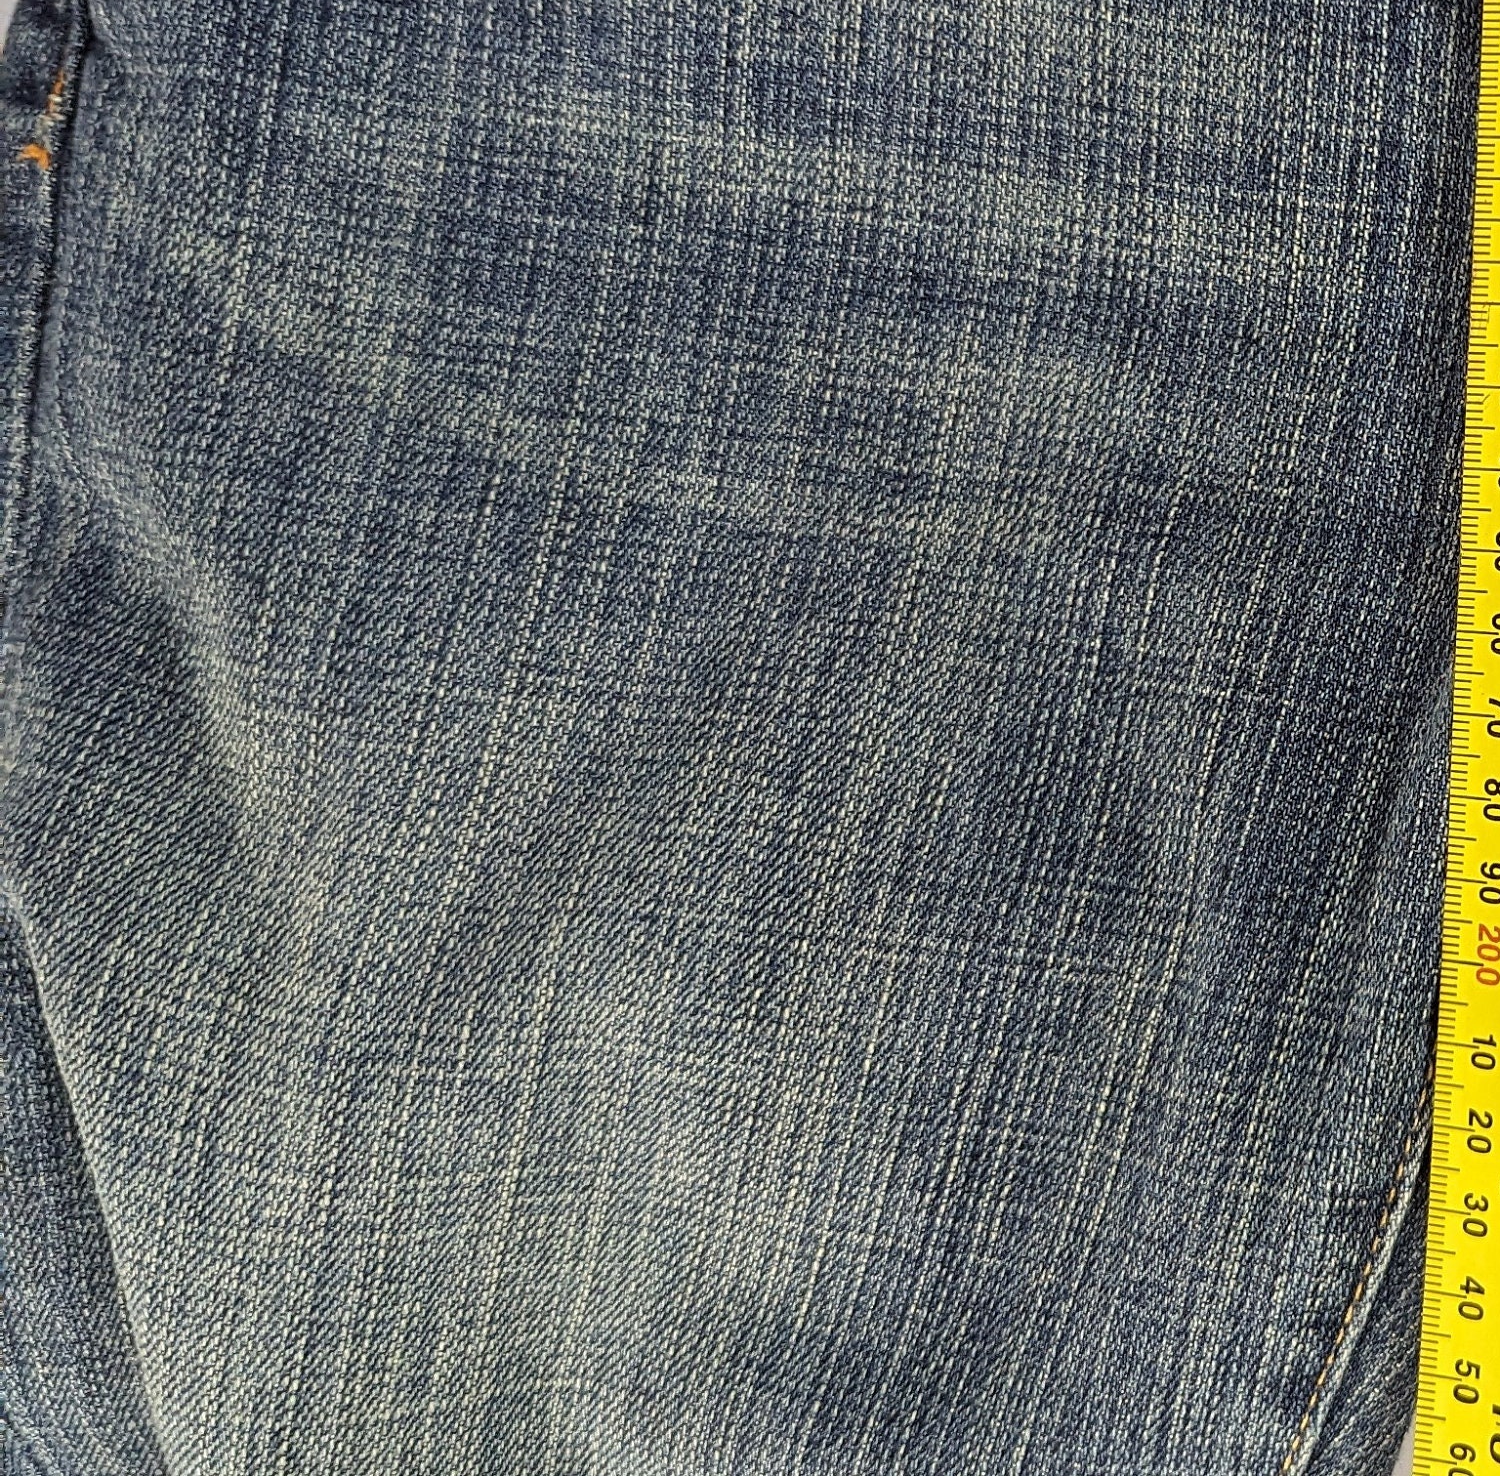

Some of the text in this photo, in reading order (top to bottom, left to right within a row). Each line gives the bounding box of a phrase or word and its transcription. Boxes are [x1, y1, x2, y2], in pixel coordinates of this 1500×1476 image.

[1470, 1034, 1497, 1070] 10
[1466, 1108, 1493, 1154] 20
[1462, 1192, 1489, 1238] 30
[1458, 1276, 1485, 1321] 40
[1453, 1358, 1481, 1405] 50
